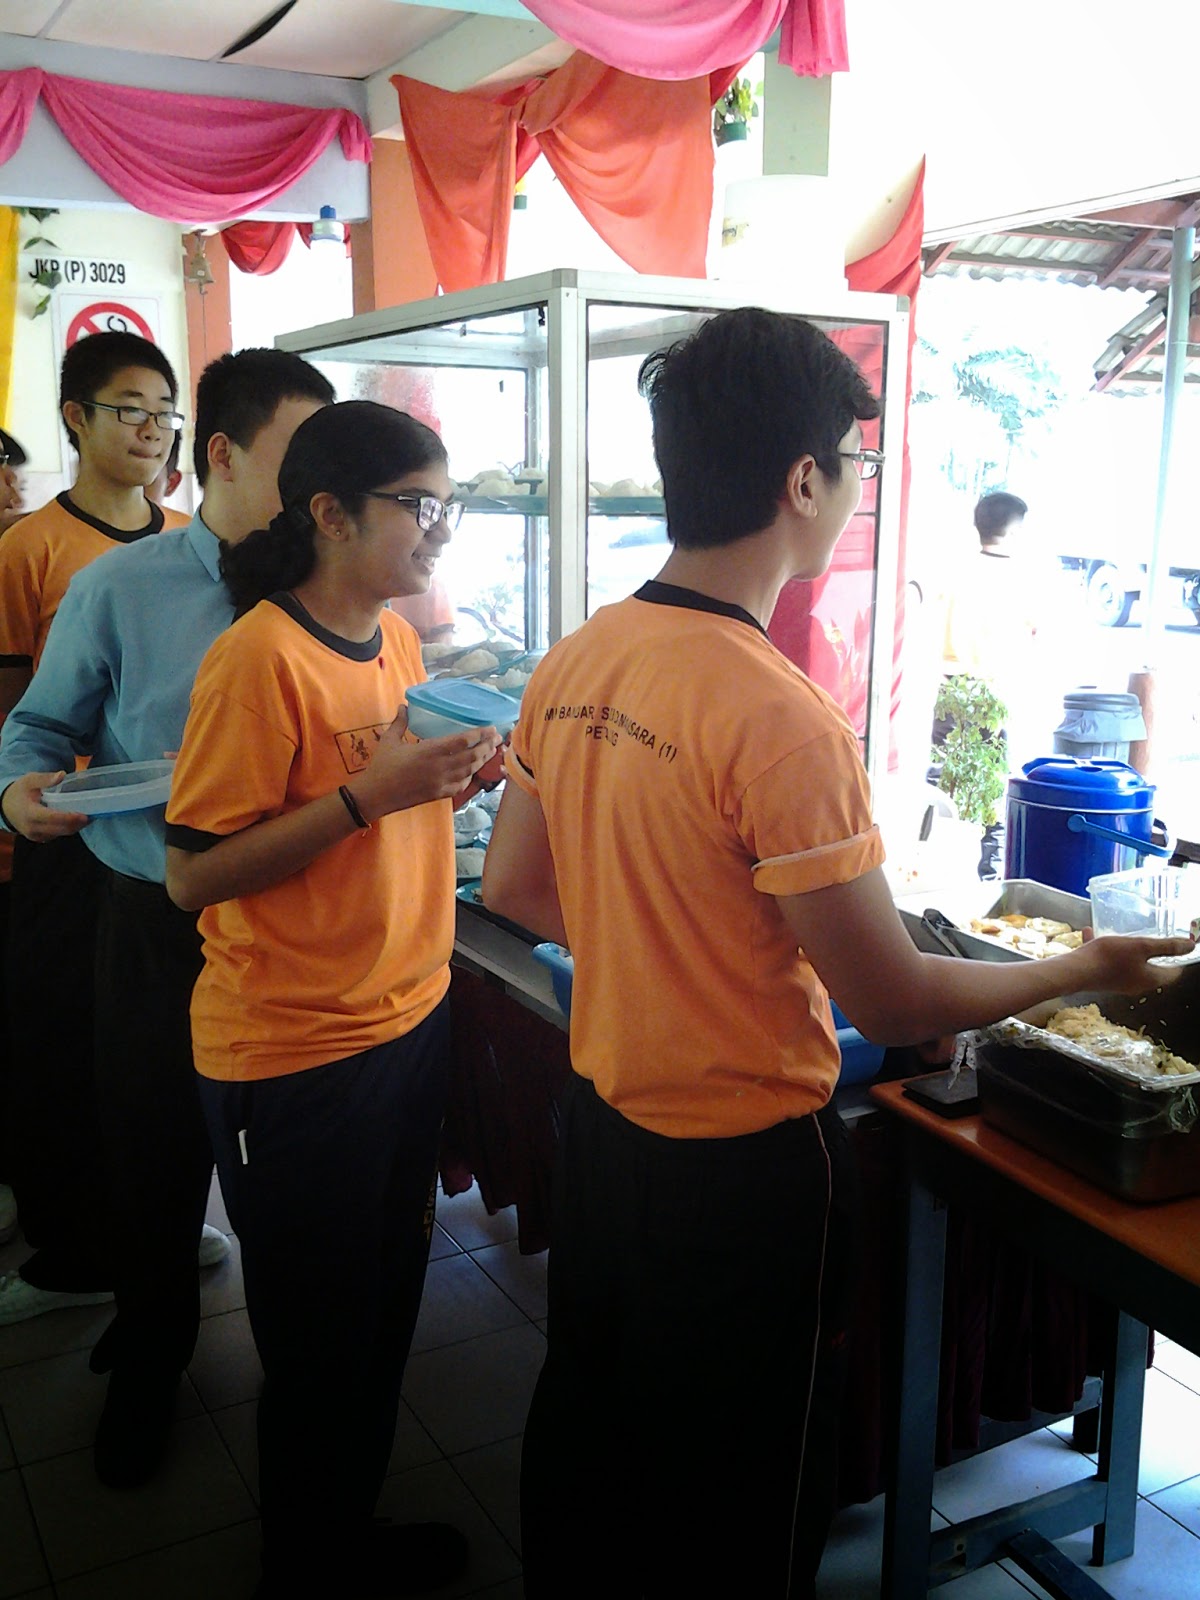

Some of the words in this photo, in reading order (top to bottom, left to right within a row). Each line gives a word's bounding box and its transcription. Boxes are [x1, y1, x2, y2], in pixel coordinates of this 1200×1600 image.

[64, 260, 86, 283] (P)
[90, 262, 126, 284] 3029
[658, 741, 677, 763] (1)
